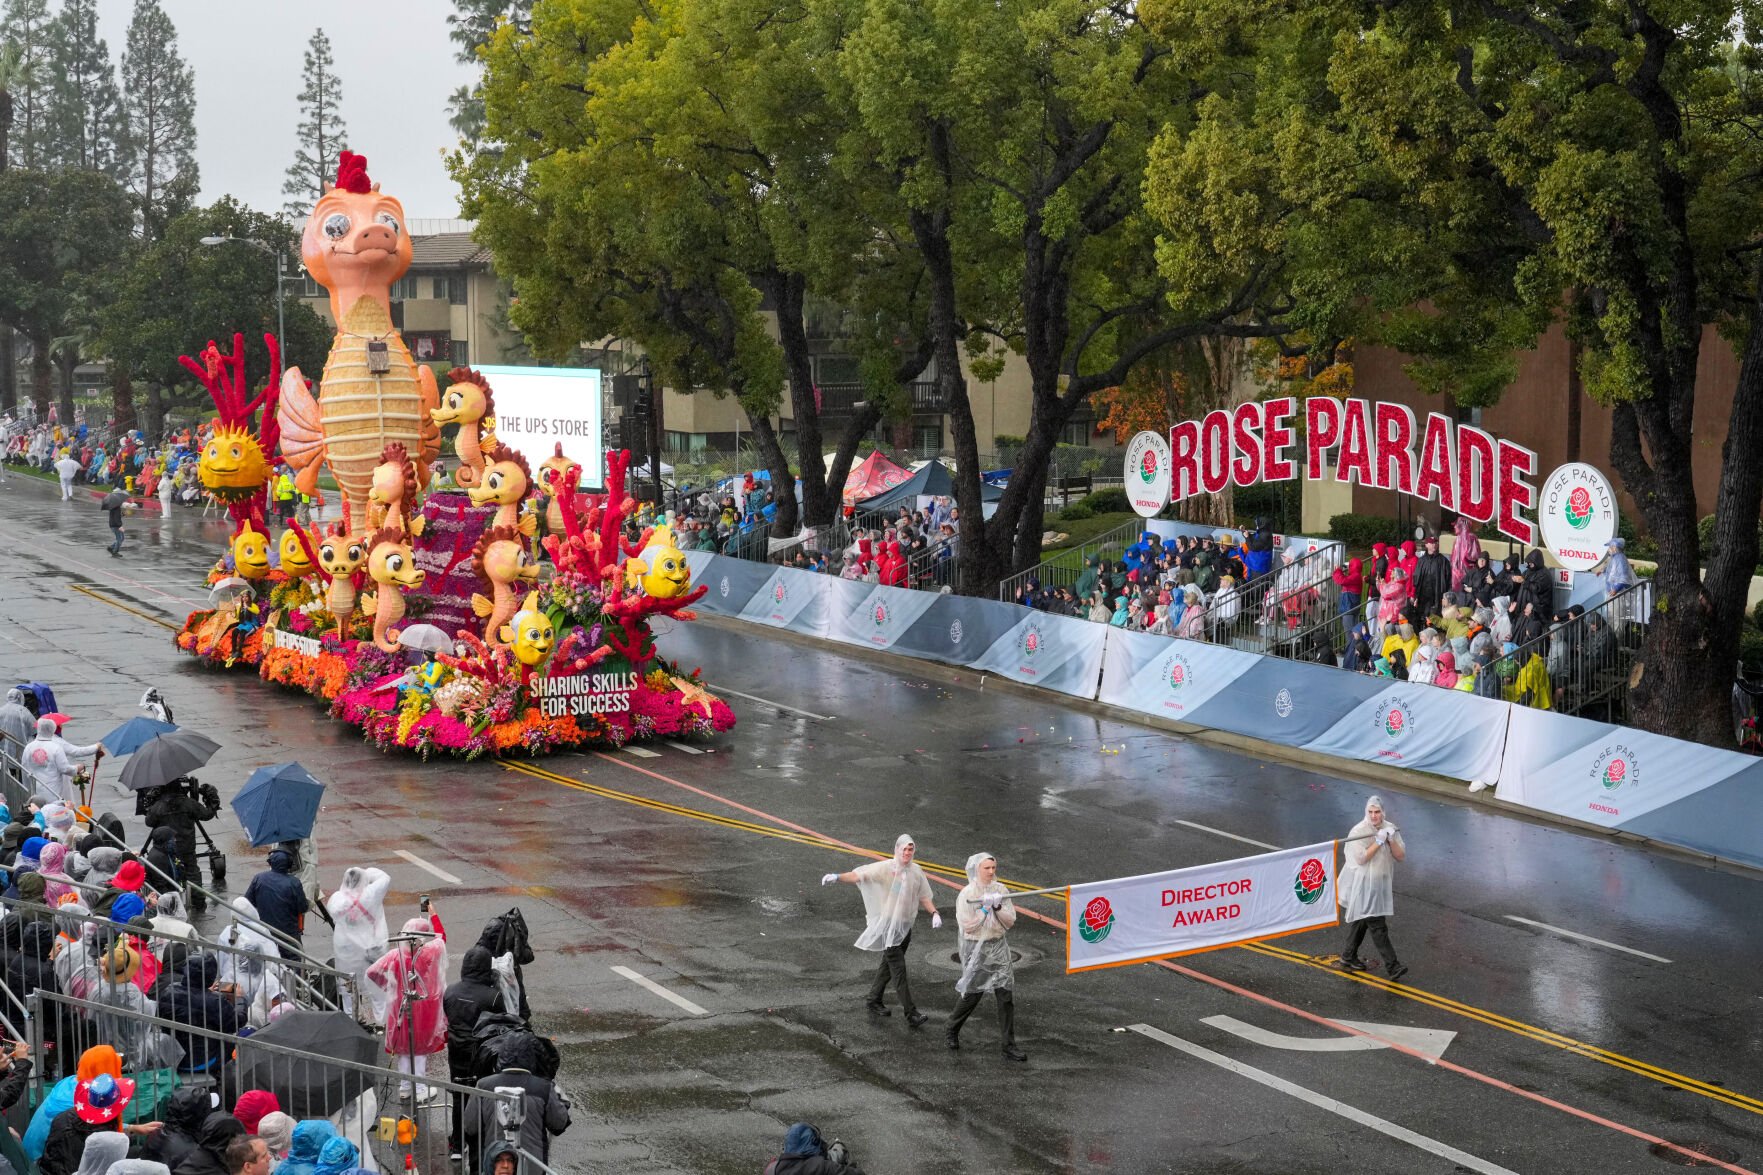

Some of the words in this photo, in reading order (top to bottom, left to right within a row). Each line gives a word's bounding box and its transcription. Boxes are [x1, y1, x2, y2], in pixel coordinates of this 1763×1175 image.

[500, 416, 521, 433] THE
[525, 417, 548, 434] UPS
[552, 418, 589, 437] STORE
[1129, 440, 1144, 473] ROSE
[1145, 435, 1168, 476] PARADE
[1170, 397, 1297, 504] ROSE
[1305, 397, 1538, 547] PARADE
[1135, 499, 1161, 509] HONDA
[1548, 473, 1569, 515] ROSE
[1572, 468, 1612, 521] PARADE
[1559, 548, 1599, 561] HONDA
[1559, 570, 1569, 582] 15
[529, 675, 589, 698] SHARING
[592, 671, 638, 693] SKILLS
[540, 697, 567, 717] FOR
[570, 692, 630, 716] SUCCESS
[1374, 698, 1389, 728] ROSE
[1589, 746, 1613, 778] ROSE
[1615, 744, 1640, 788] PARADE
[1588, 802, 1620, 816] HONDA
[1161, 878, 1252, 907] DIRECTOR
[1172, 904, 1241, 928] AWARD
